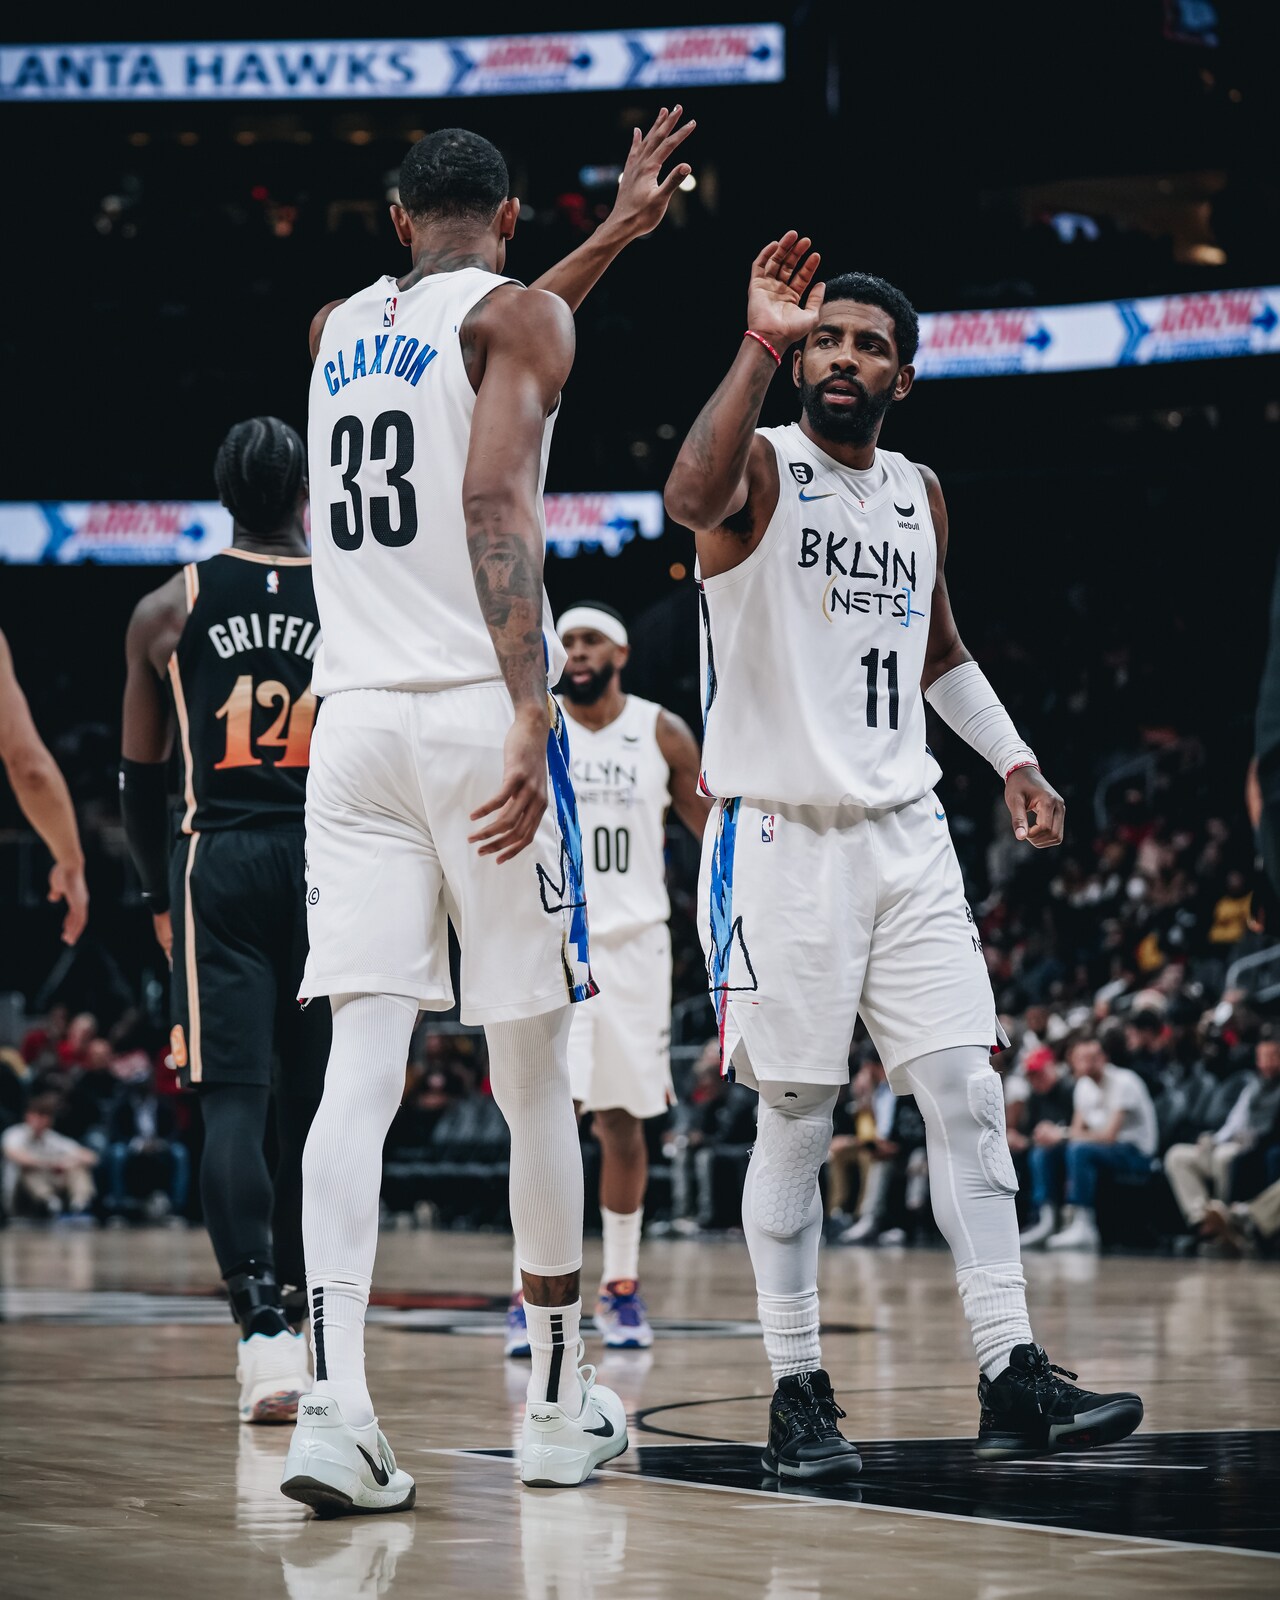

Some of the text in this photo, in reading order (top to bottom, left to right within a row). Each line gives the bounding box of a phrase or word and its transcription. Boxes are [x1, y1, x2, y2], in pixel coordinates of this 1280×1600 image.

[185, 50, 417, 87] HAWKS
[323, 334, 438, 396] CLAXTON
[330, 410, 418, 551] 33
[897, 520, 920, 531] Webull
[798, 527, 916, 592] BKLYN
[861, 647, 900, 731] 11
[594, 826, 629, 873] 00
